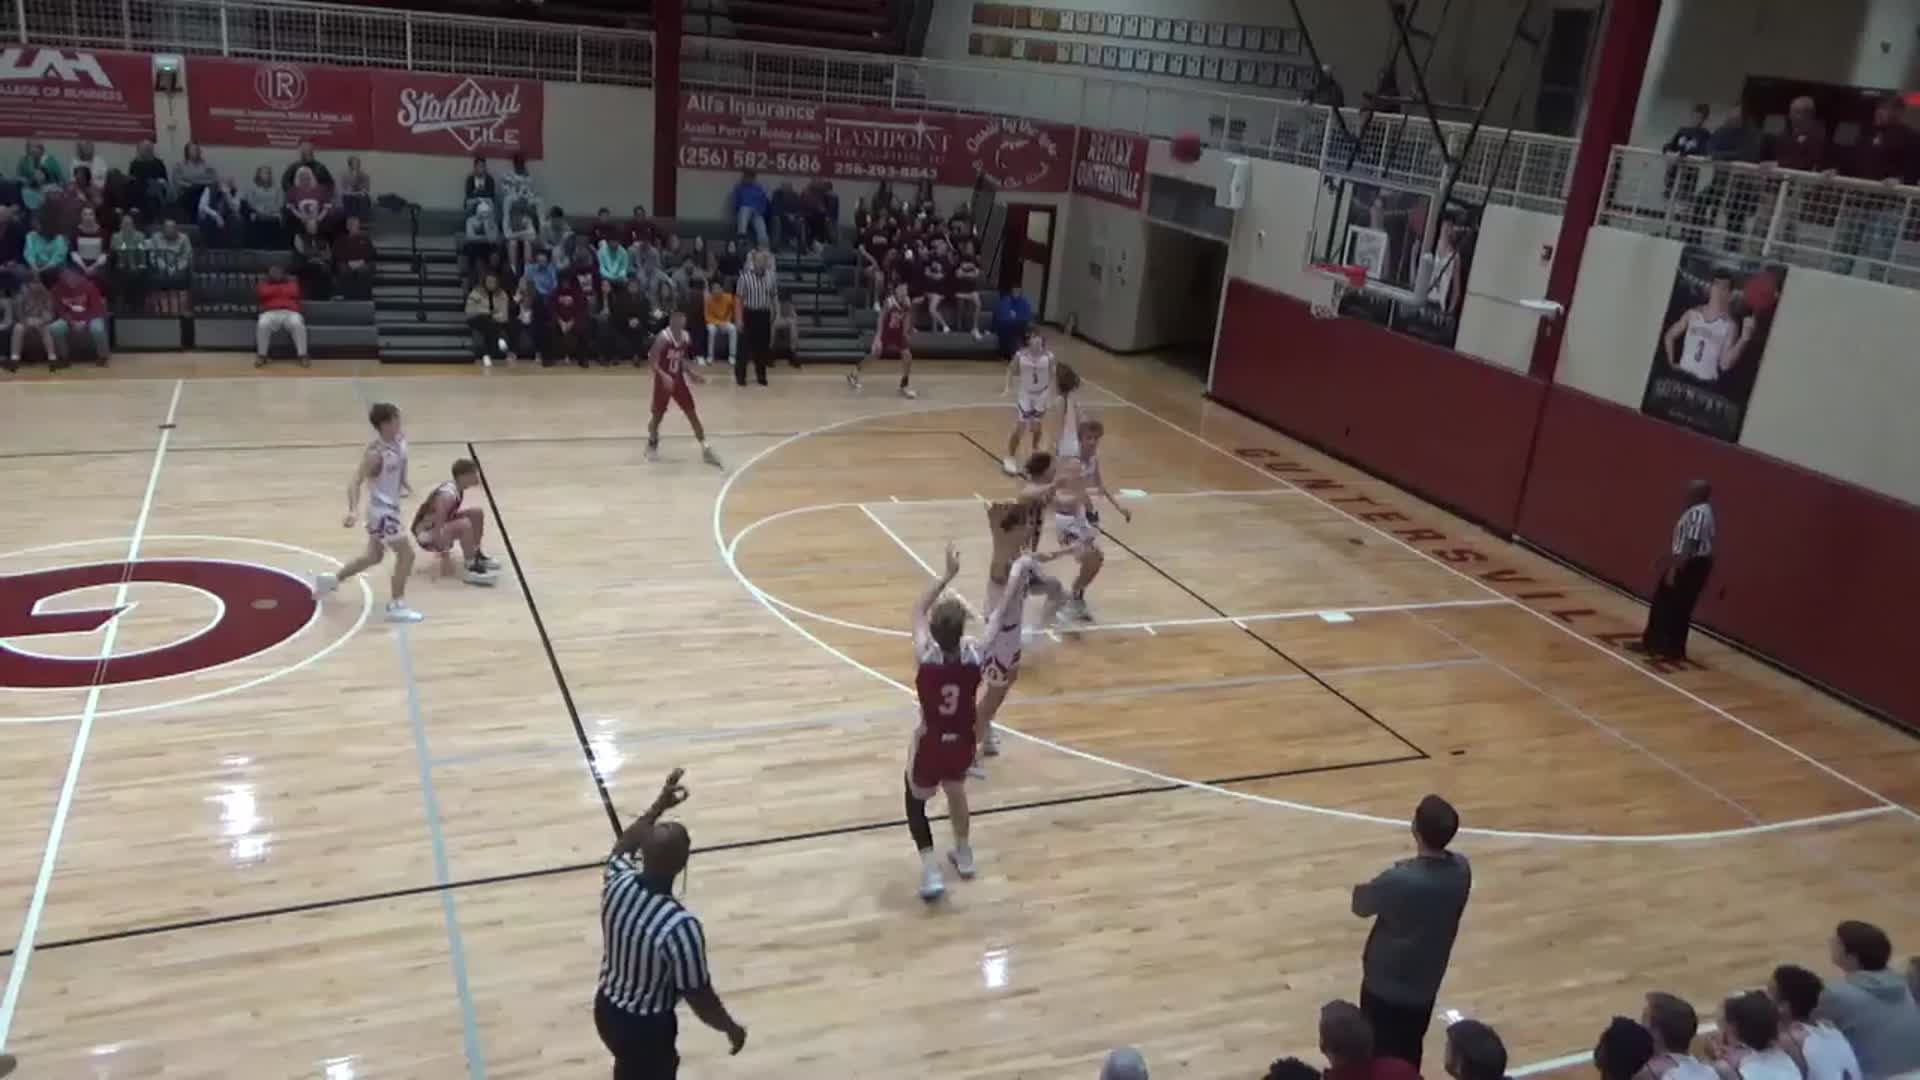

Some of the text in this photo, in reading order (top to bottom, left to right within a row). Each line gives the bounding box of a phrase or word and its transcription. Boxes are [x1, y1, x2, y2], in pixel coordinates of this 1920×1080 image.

[398, 83, 522, 127] Standard
[729, 95, 816, 121] Insurance
[464, 126, 519, 145] TILE
[824, 125, 953, 152] FLASHPOINT
[679, 145, 821, 172] (256) 582-5686
[938, 684, 960, 716] 3
